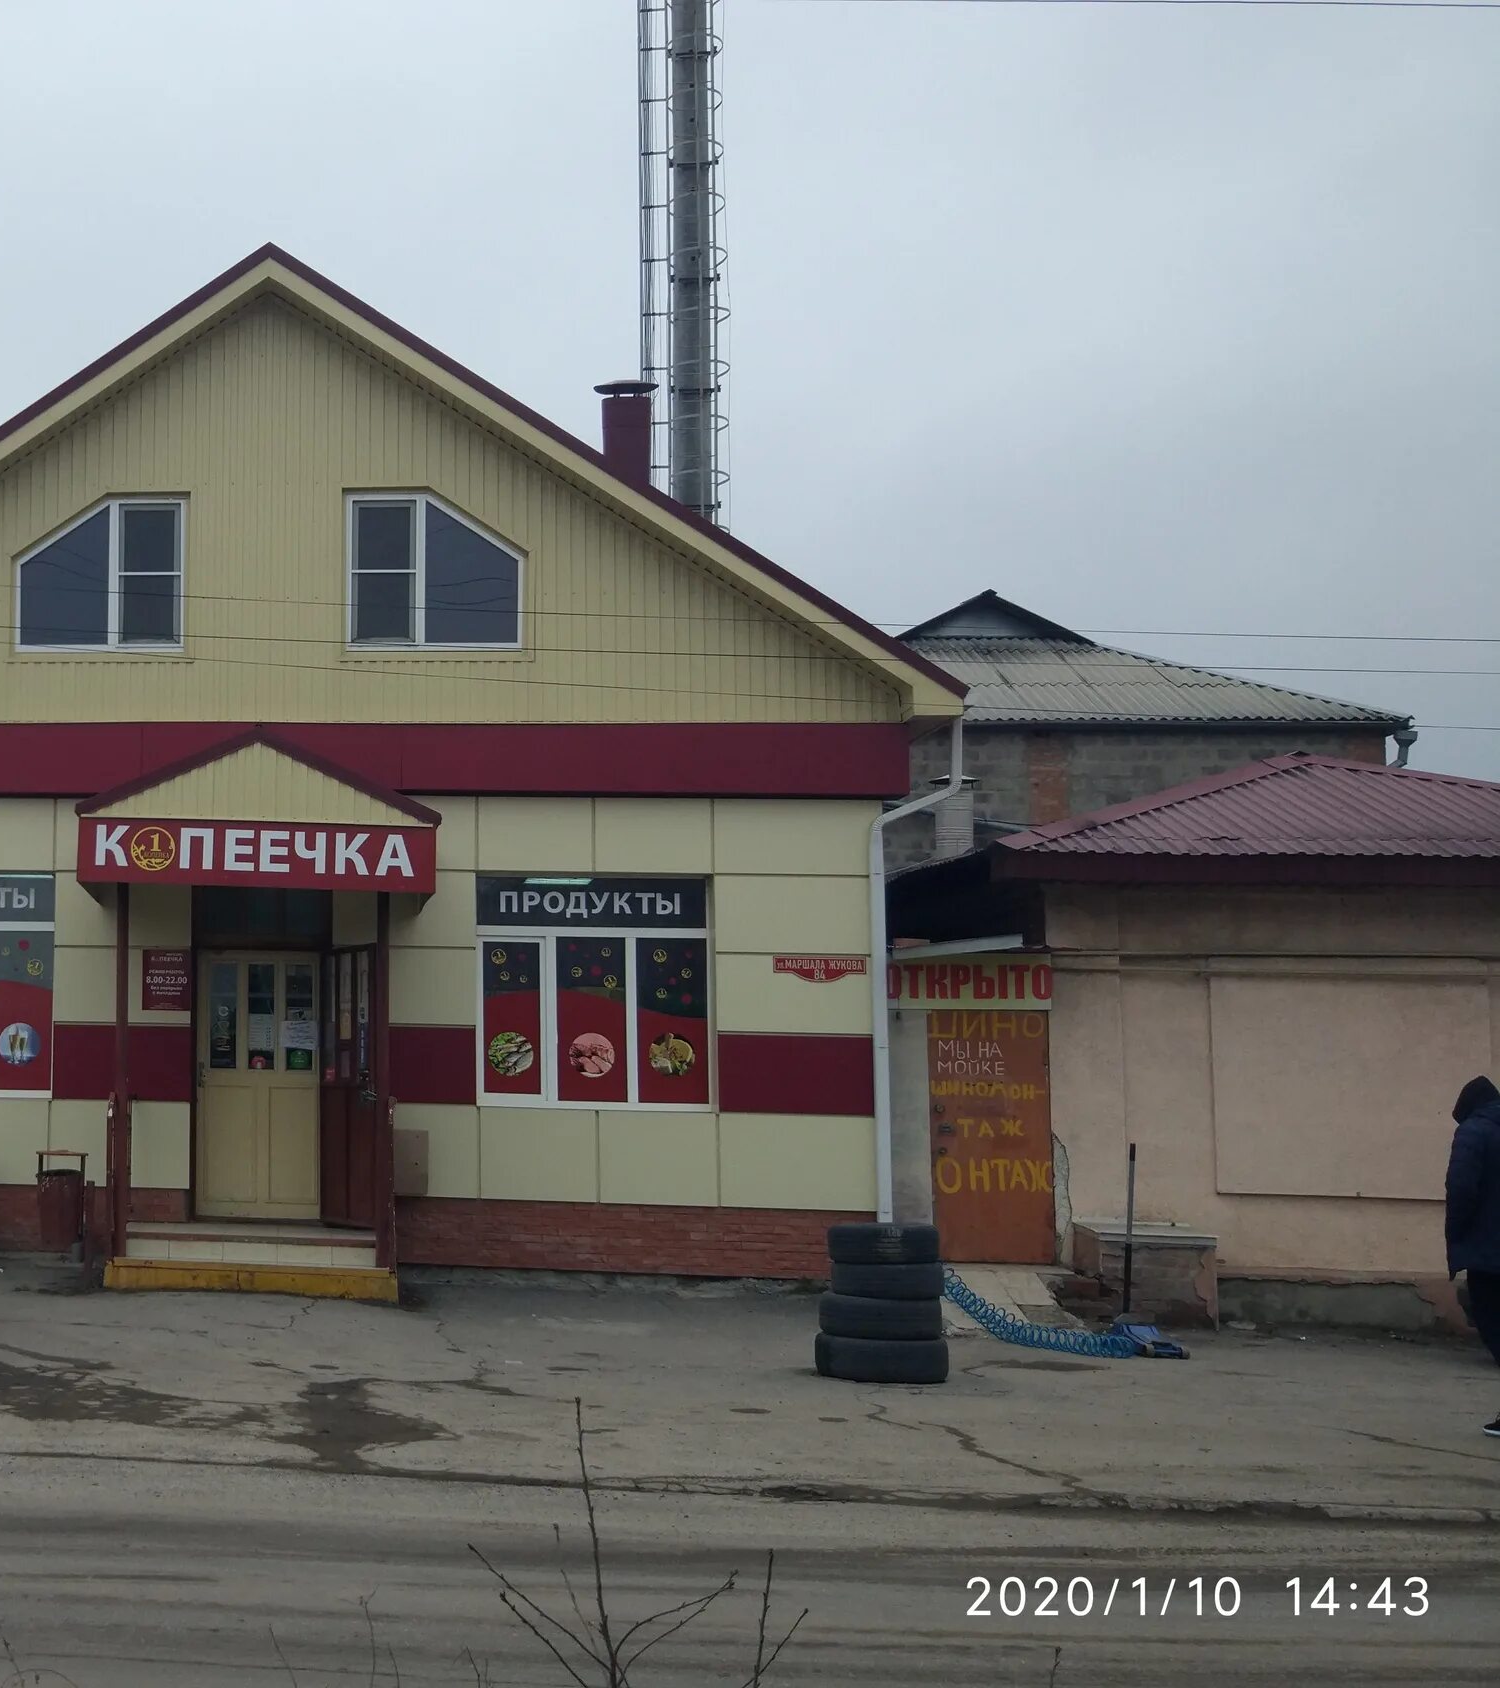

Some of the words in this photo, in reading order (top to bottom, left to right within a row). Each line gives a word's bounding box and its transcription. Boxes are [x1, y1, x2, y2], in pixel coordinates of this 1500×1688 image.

[499, 890, 681, 919] ПРОДУКТЫ
[785, 959, 826, 970] МАРШАЛА
[829, 960, 863, 970] ЖУКОВА
[146, 976, 188, 984] 8.00-22.00
[887, 964, 1053, 1000] ОТКРЫТО
[938, 1040, 970, 1060] МЫ
[979, 1041, 1003, 1058] НА
[937, 1059, 1005, 1076] МОЙКЕ
